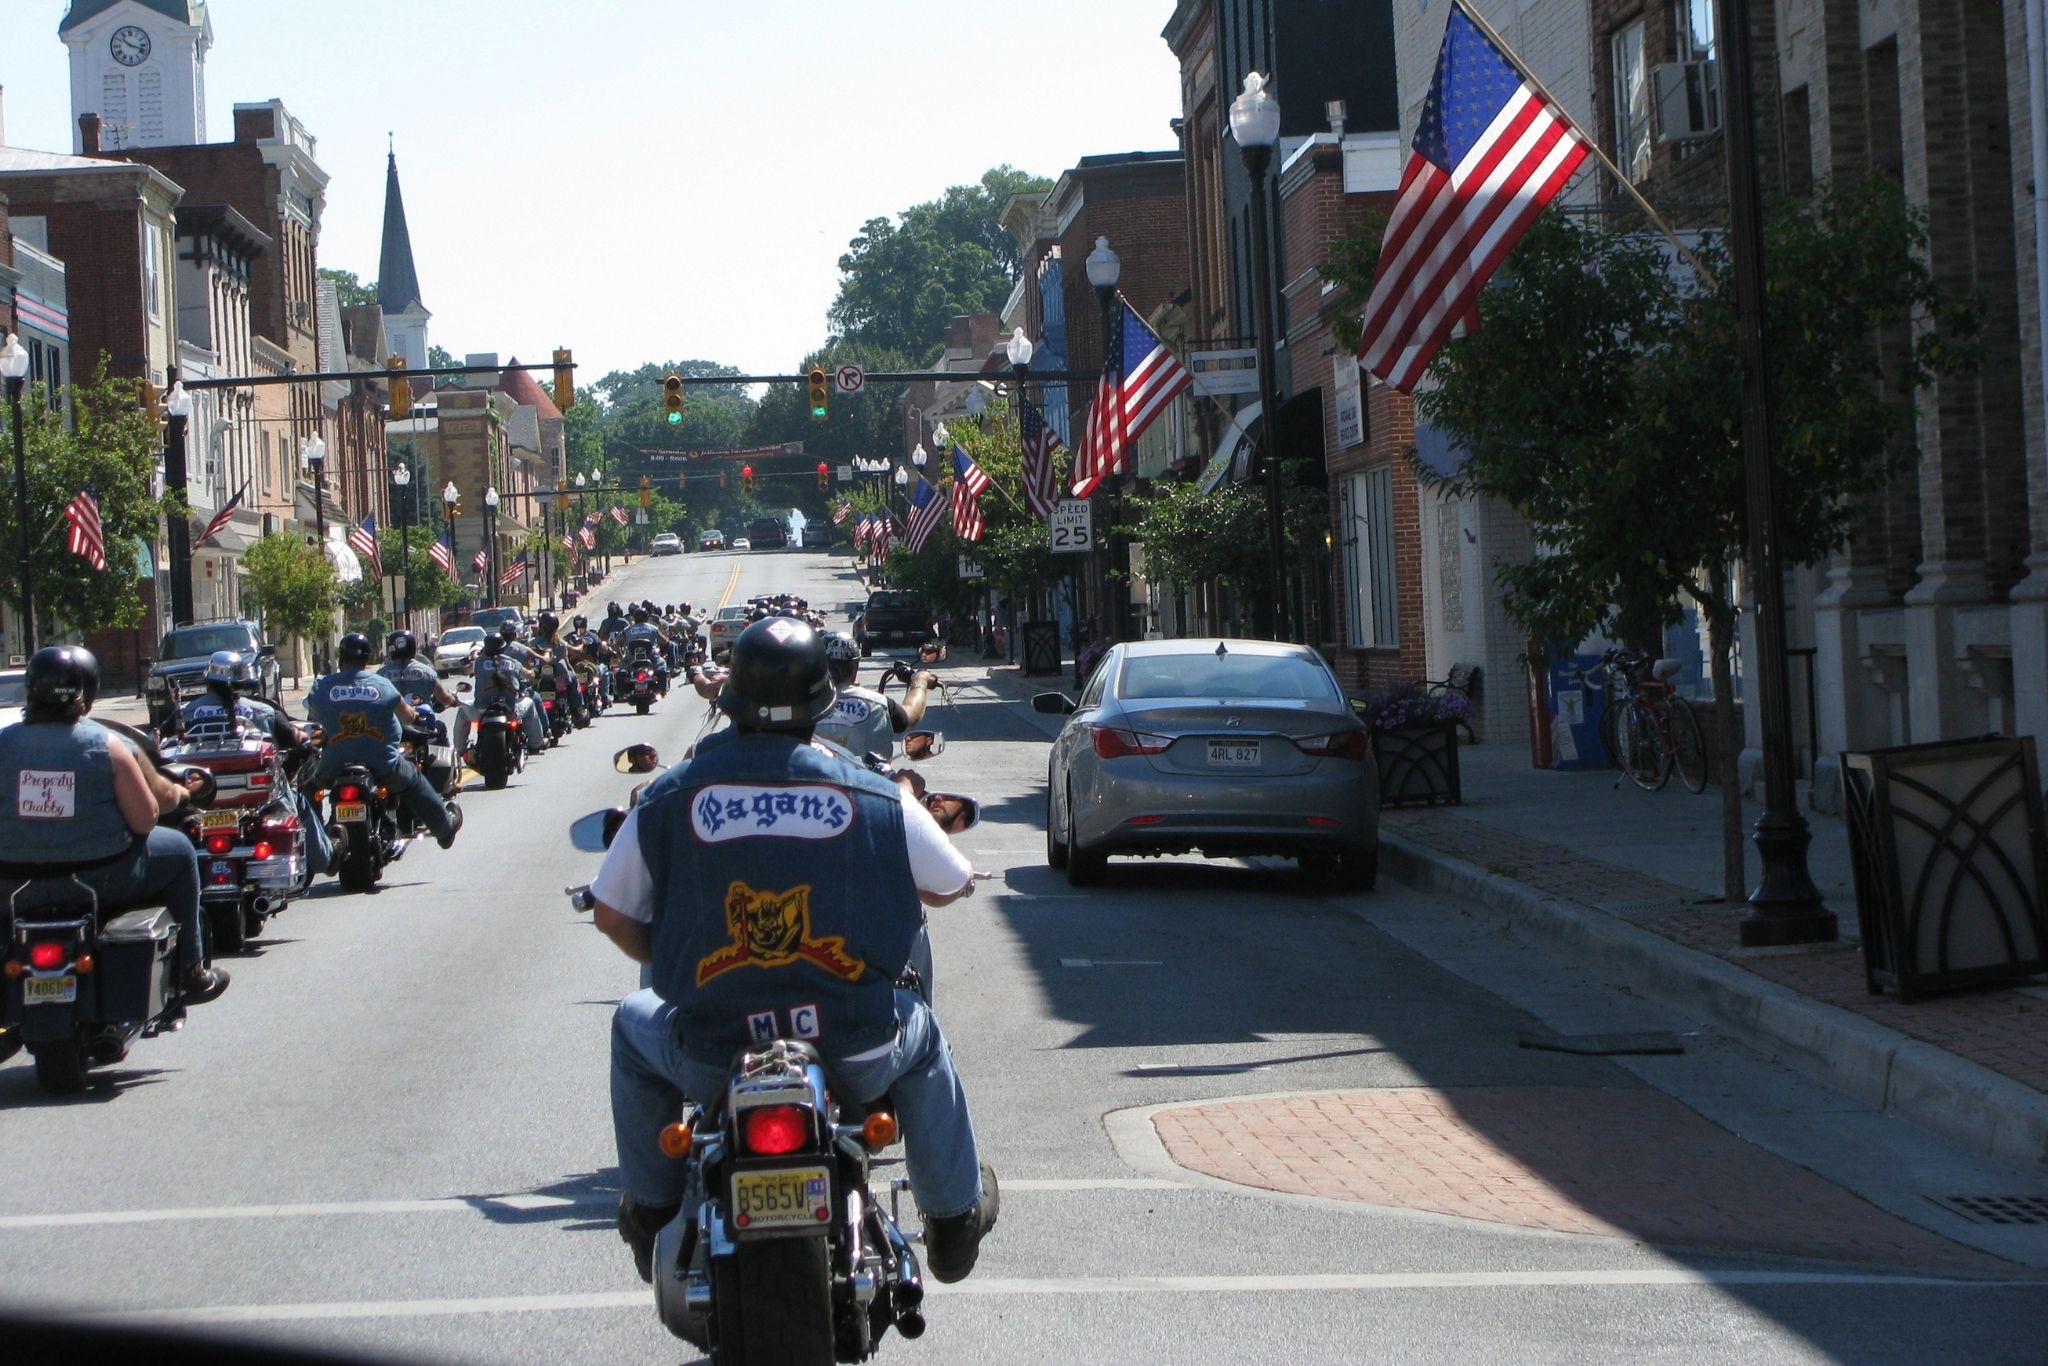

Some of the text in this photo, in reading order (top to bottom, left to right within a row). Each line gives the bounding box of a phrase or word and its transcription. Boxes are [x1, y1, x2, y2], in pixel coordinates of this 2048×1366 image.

[1053, 505, 1088, 514] SPEED
[1057, 516, 1084, 524] LIMIT
[1055, 526, 1088, 546] 25
[1236, 748, 1258, 761] 827
[22, 771, 74, 792] Property
[22, 799, 65, 816] Chubby
[698, 791, 849, 836] Pagan's
[738, 1182, 804, 1211] 8565V
